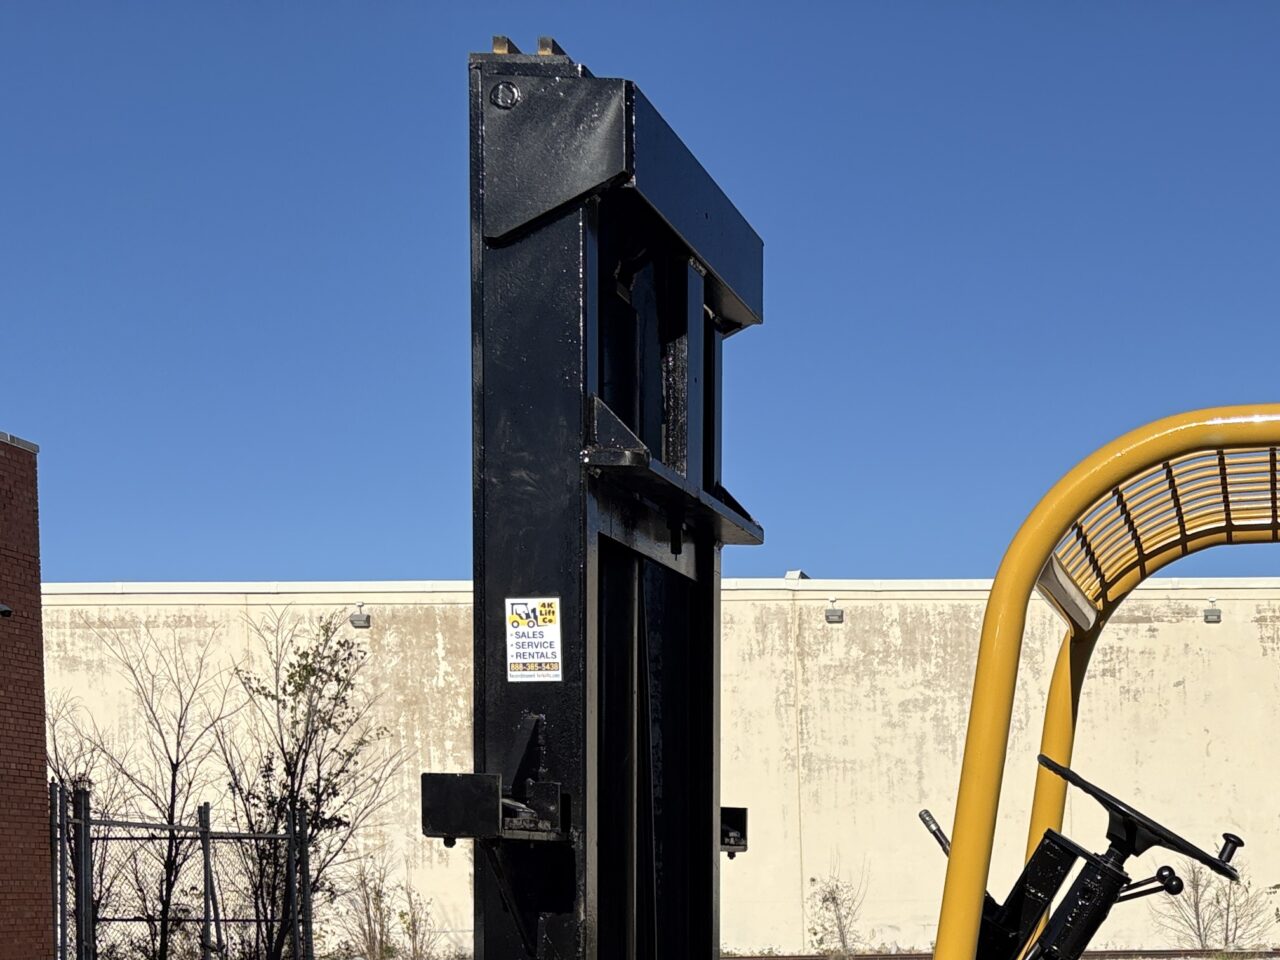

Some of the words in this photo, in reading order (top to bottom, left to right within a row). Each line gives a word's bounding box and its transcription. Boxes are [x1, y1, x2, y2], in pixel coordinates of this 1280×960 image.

[515, 631, 544, 639] SALES
[515, 641, 555, 649] SERVICE
[515, 651, 557, 660] RENTALS
